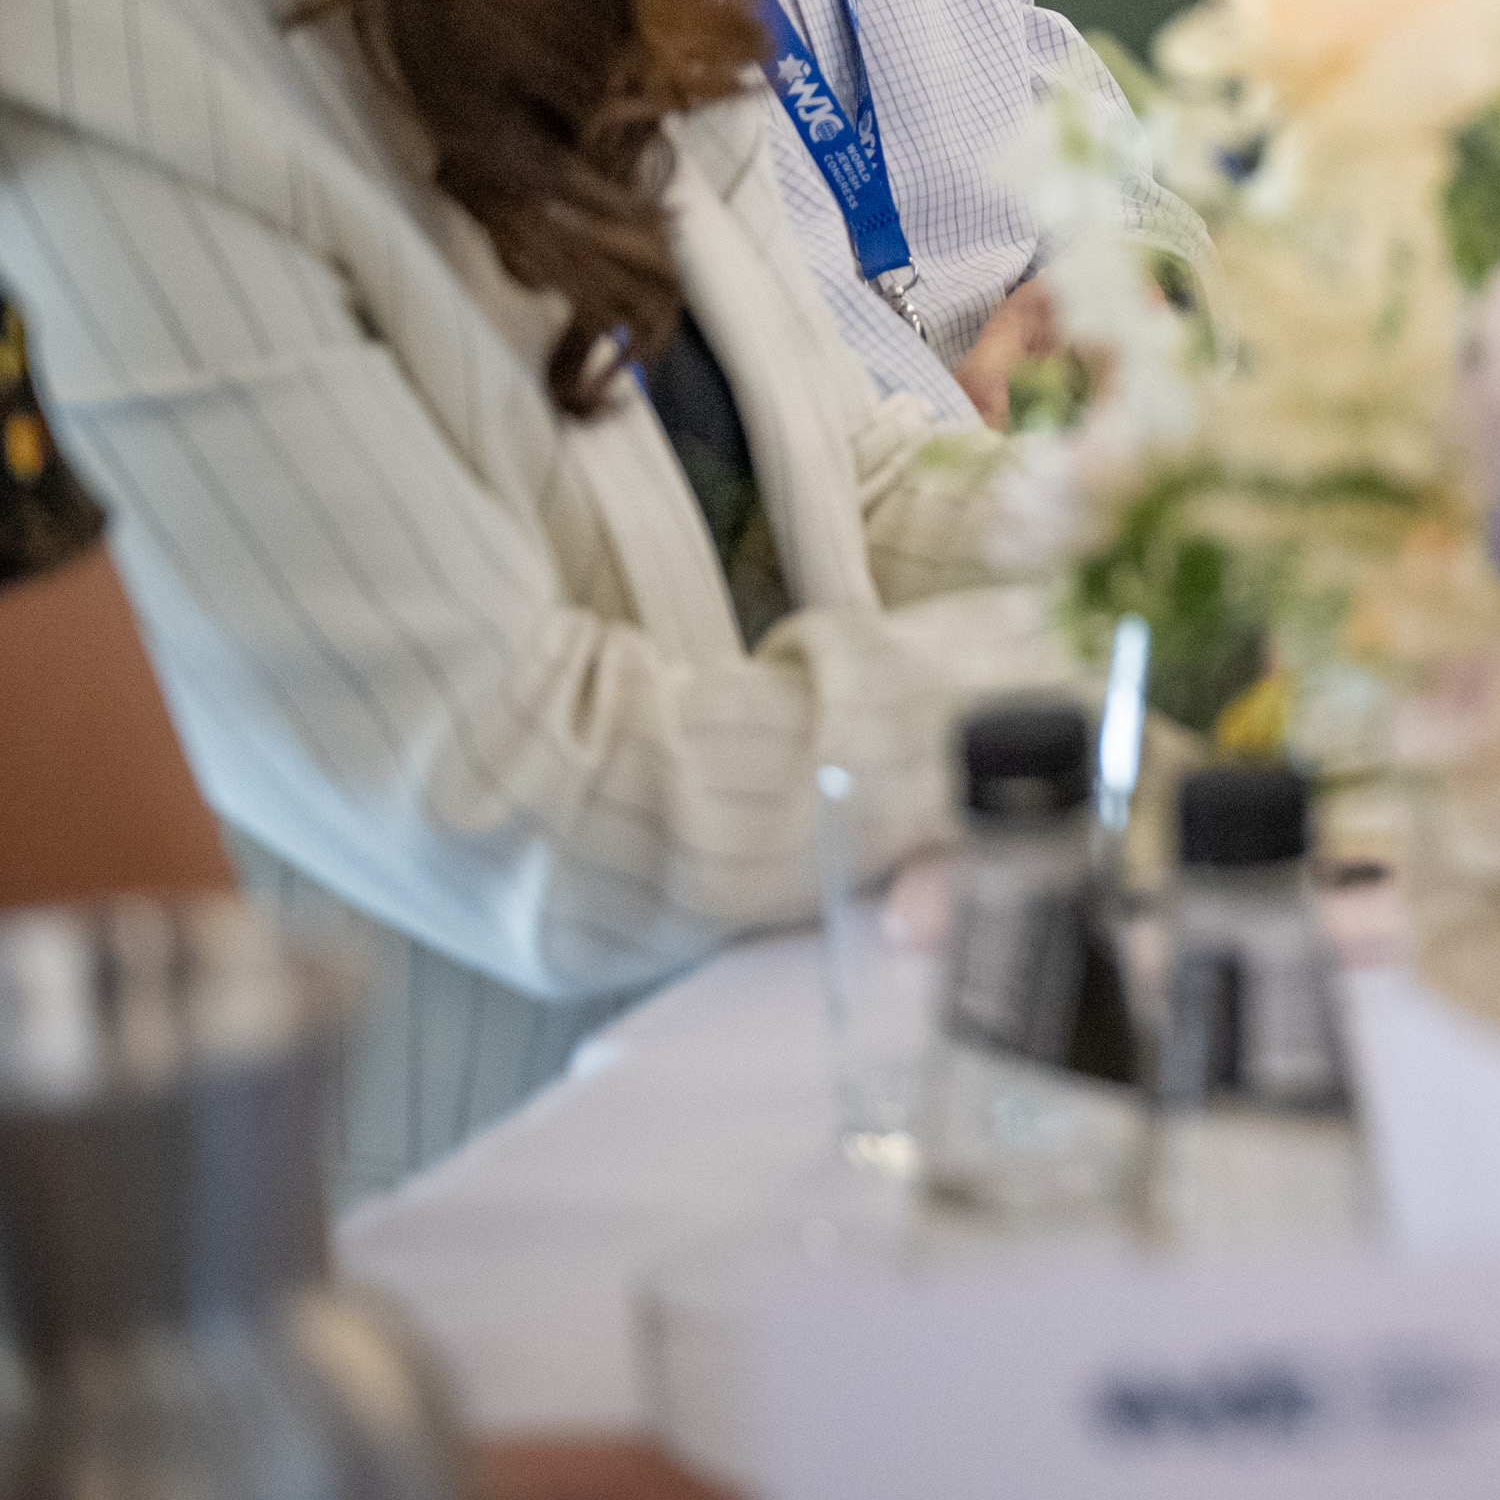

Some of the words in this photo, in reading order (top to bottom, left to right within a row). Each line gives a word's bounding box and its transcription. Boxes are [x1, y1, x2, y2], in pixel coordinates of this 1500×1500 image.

[823, 153, 859, 211] CONGRESS
[834, 150, 862, 191] JEWISH
[846, 143, 871, 183] WORLD
